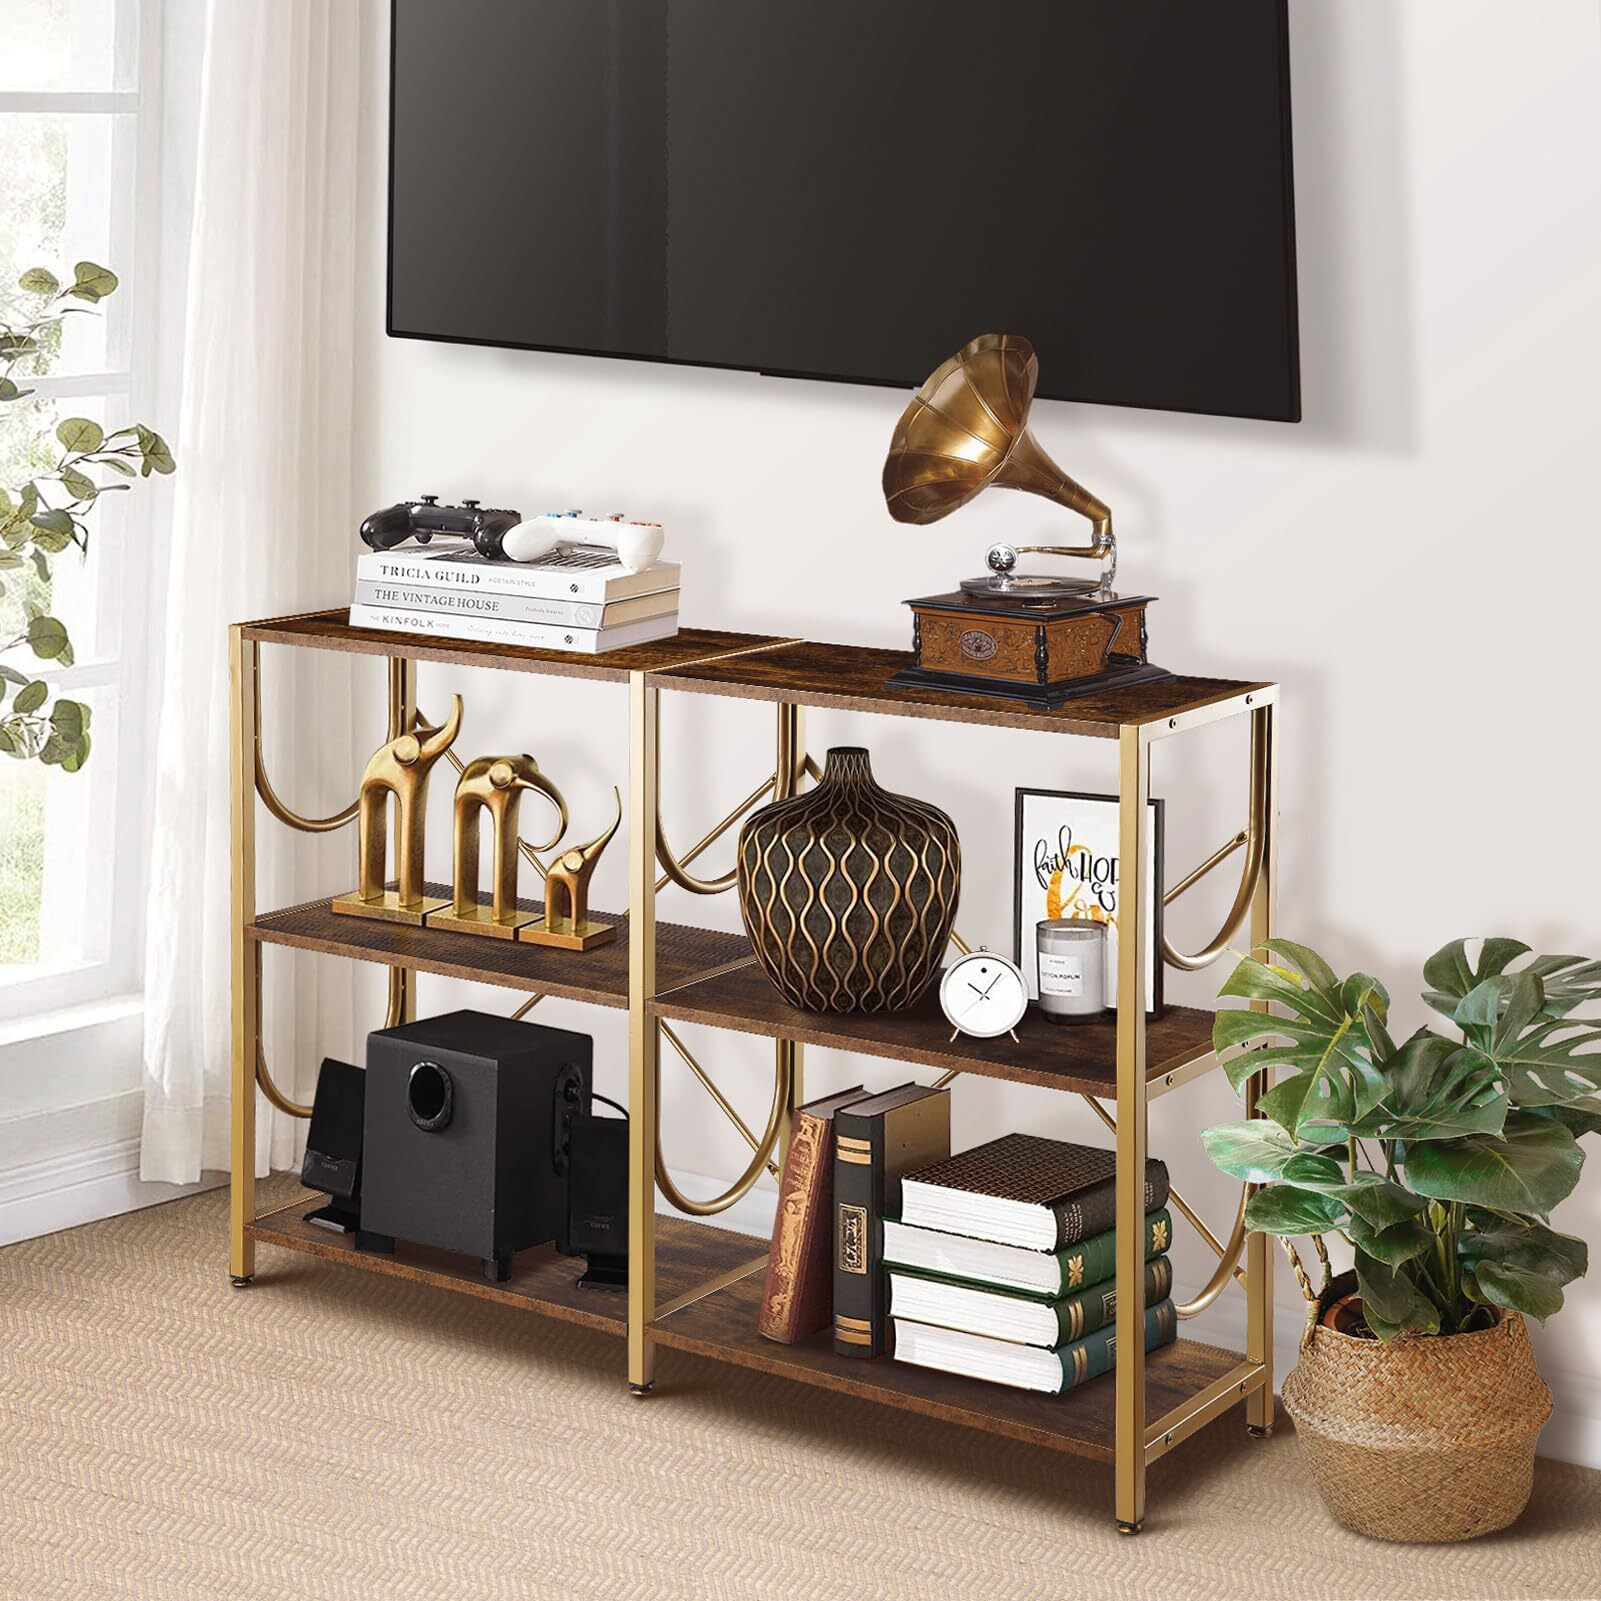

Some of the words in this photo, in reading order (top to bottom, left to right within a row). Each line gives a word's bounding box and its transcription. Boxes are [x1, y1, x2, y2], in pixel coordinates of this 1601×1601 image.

[380, 564, 431, 580] TRICIA
[435, 570, 480, 585] GUILD
[374, 589, 399, 601] THE
[402, 591, 455, 607] VINTAGE
[456, 598, 500, 612] HOUSE
[382, 615, 434, 628] KINFOLK
[1034, 825, 1079, 890] faith
[1080, 851, 1120, 885] HOP
